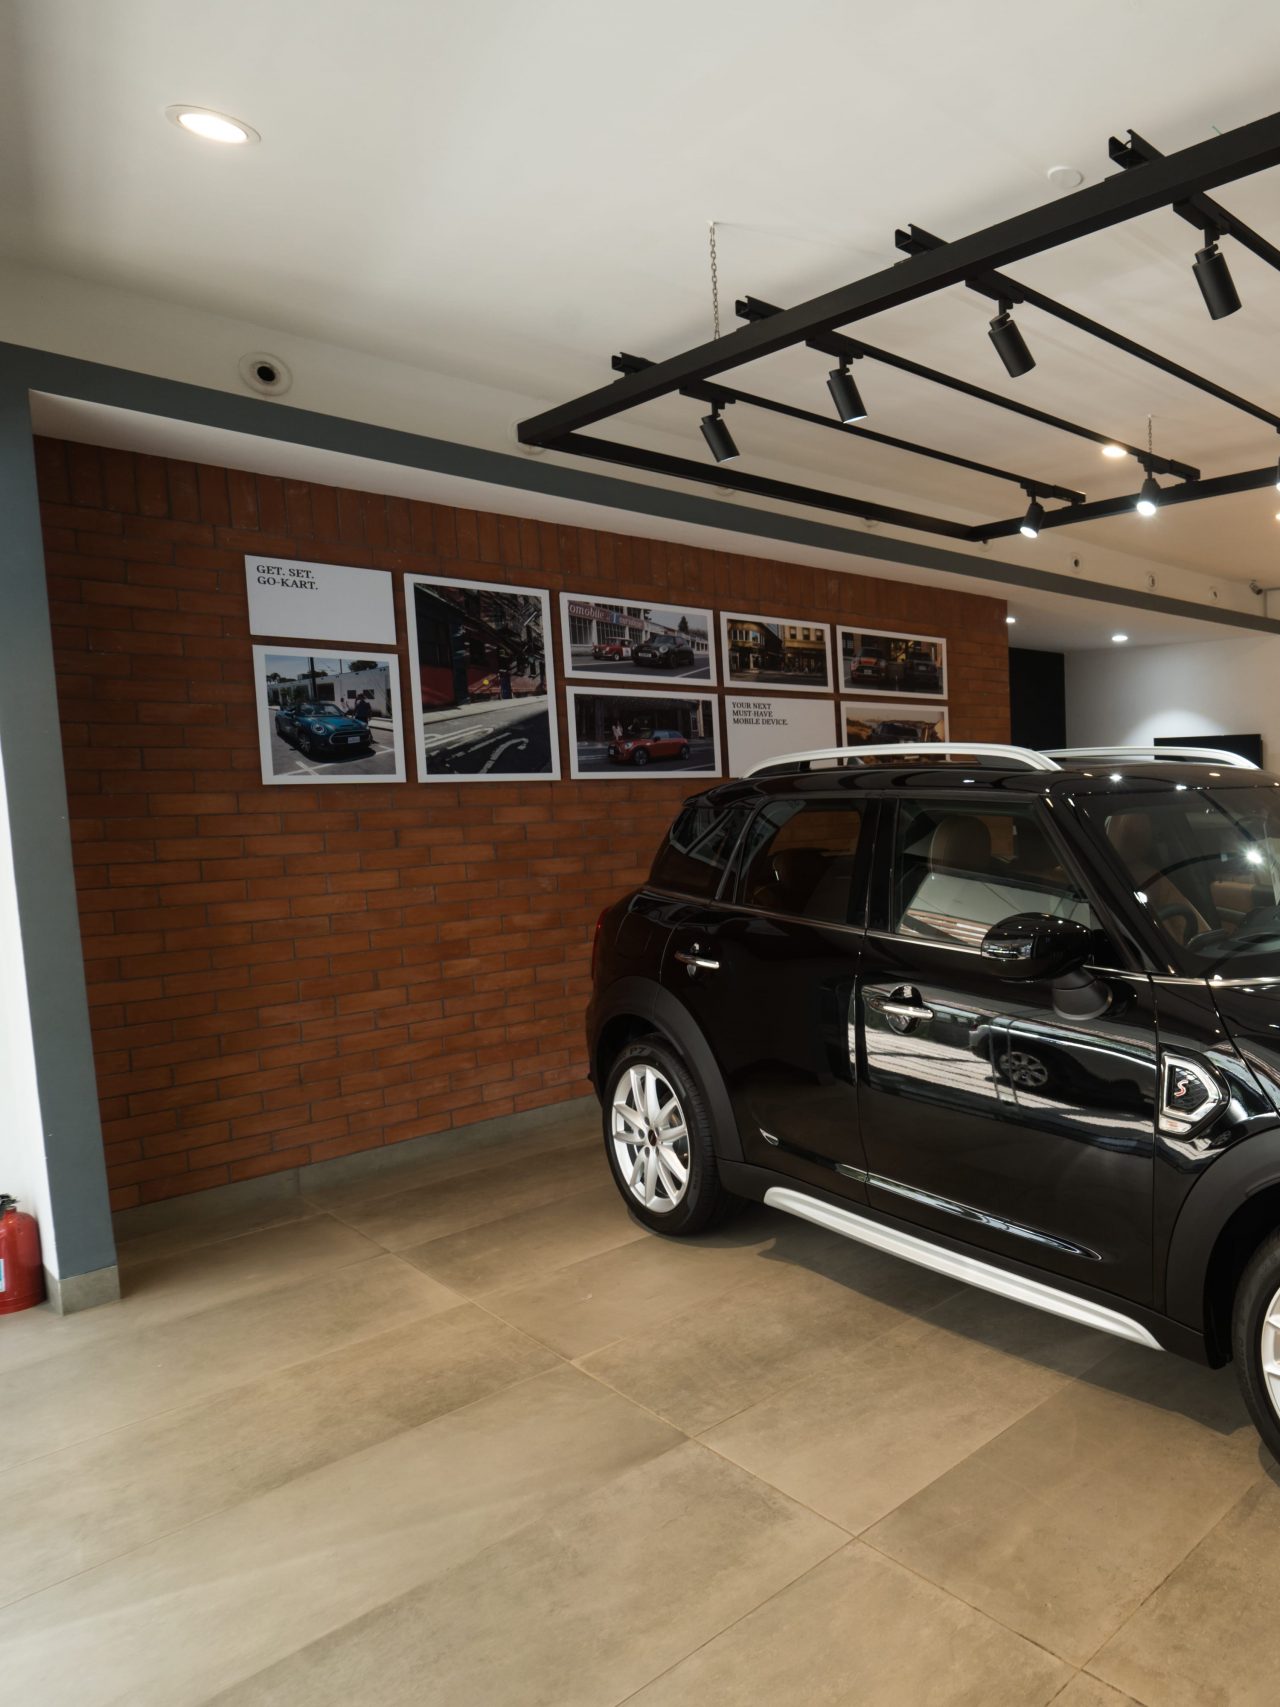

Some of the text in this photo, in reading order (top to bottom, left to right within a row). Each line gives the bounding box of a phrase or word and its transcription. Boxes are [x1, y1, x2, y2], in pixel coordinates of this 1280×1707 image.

[256, 565, 315, 578] GET. SET.
[257, 576, 319, 590] GO-KART.
[732, 701, 751, 709] YOUR
[733, 717, 789, 726] MOBILE DEVICE.
